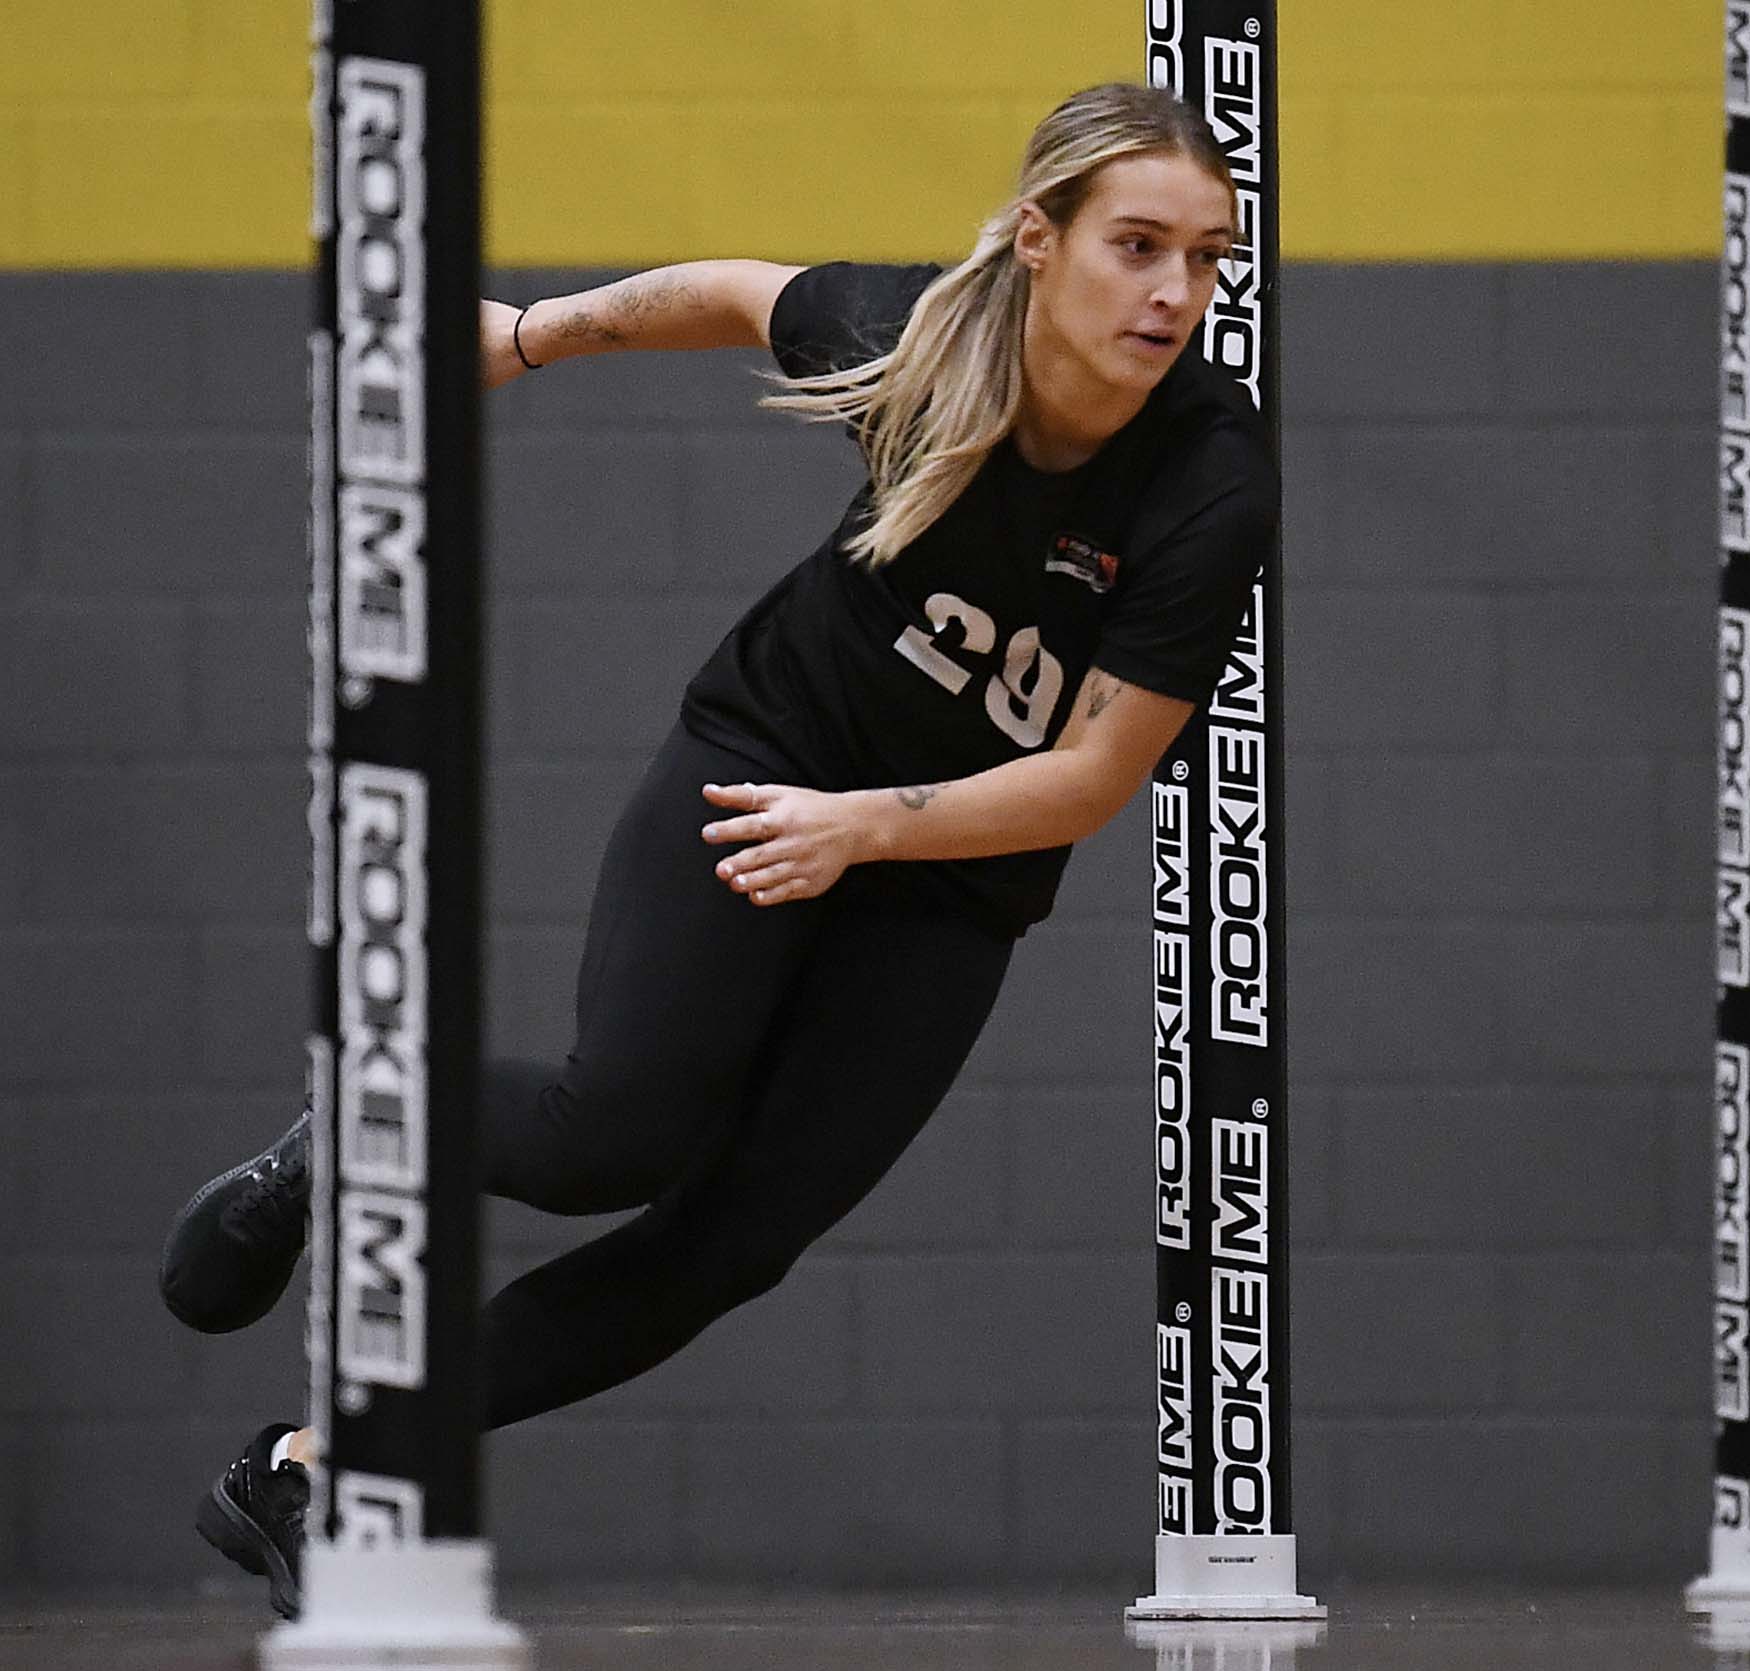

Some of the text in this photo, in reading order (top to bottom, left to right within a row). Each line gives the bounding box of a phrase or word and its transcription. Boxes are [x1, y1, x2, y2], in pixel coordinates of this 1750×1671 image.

[893, 593, 1064, 748] 29
[1209, 725, 1267, 1046] ROOKIE
[1152, 781, 1191, 1250] ROOKIE ME
[1212, 1117, 1268, 1264] ME
[1156, 1322, 1194, 1470] ME
[1212, 1266, 1271, 1536] OOKIE
